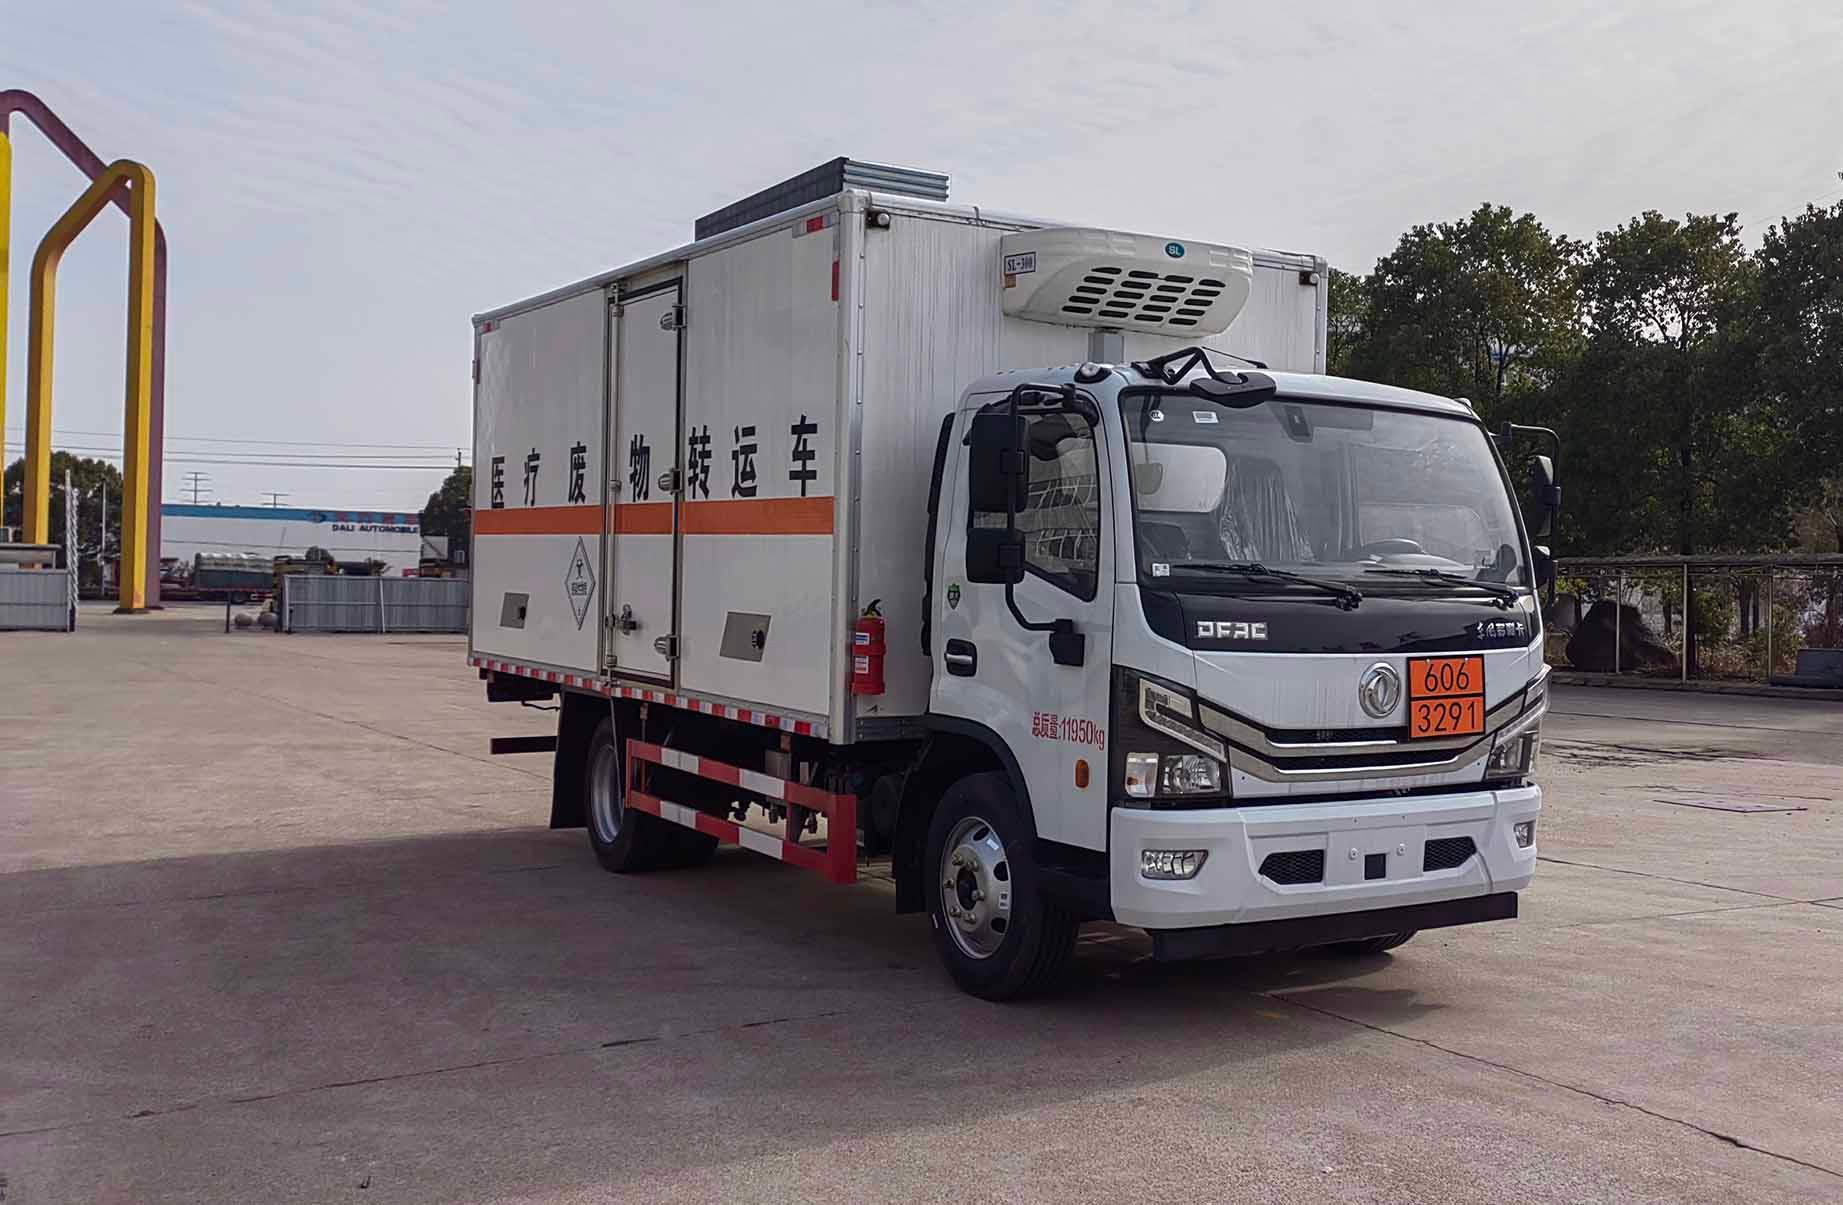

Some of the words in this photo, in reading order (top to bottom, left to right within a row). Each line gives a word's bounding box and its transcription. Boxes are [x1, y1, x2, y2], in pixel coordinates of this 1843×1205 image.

[1168, 246, 1181, 256] SL
[1007, 256, 1033, 271] SL-300
[491, 414, 818, 508] 医疗废物转运车
[332, 524, 354, 532] DALI
[1197, 621, 1267, 639] DFAC
[1424, 662, 1470, 692] 606
[1418, 701, 1475, 733] 3291
